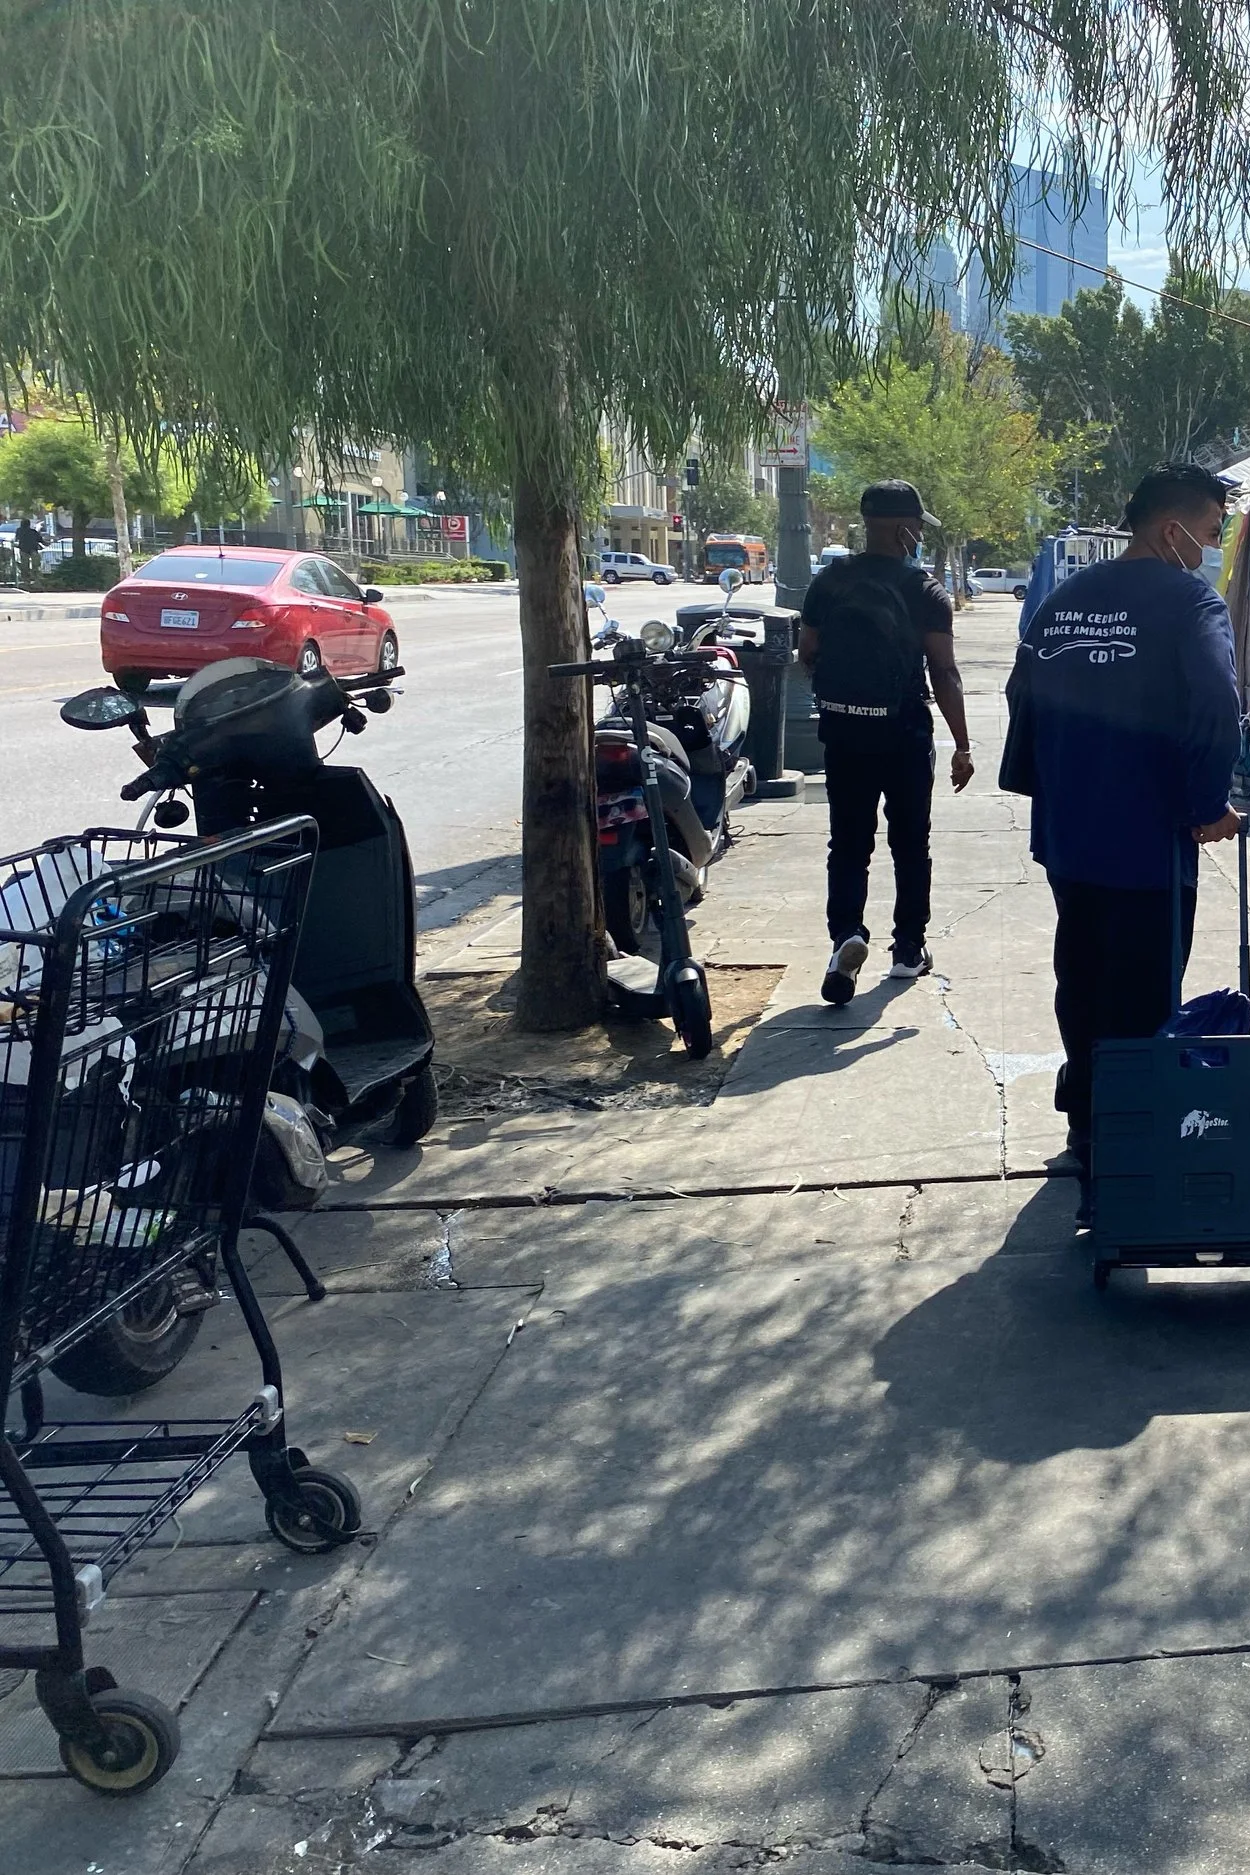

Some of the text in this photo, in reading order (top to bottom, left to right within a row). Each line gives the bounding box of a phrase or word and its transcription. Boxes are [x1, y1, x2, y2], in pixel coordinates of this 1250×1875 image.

[1055, 611, 1083, 622] TEAM
[1043, 625, 1072, 637] PEACE
[847, 704, 888, 717] NATION
